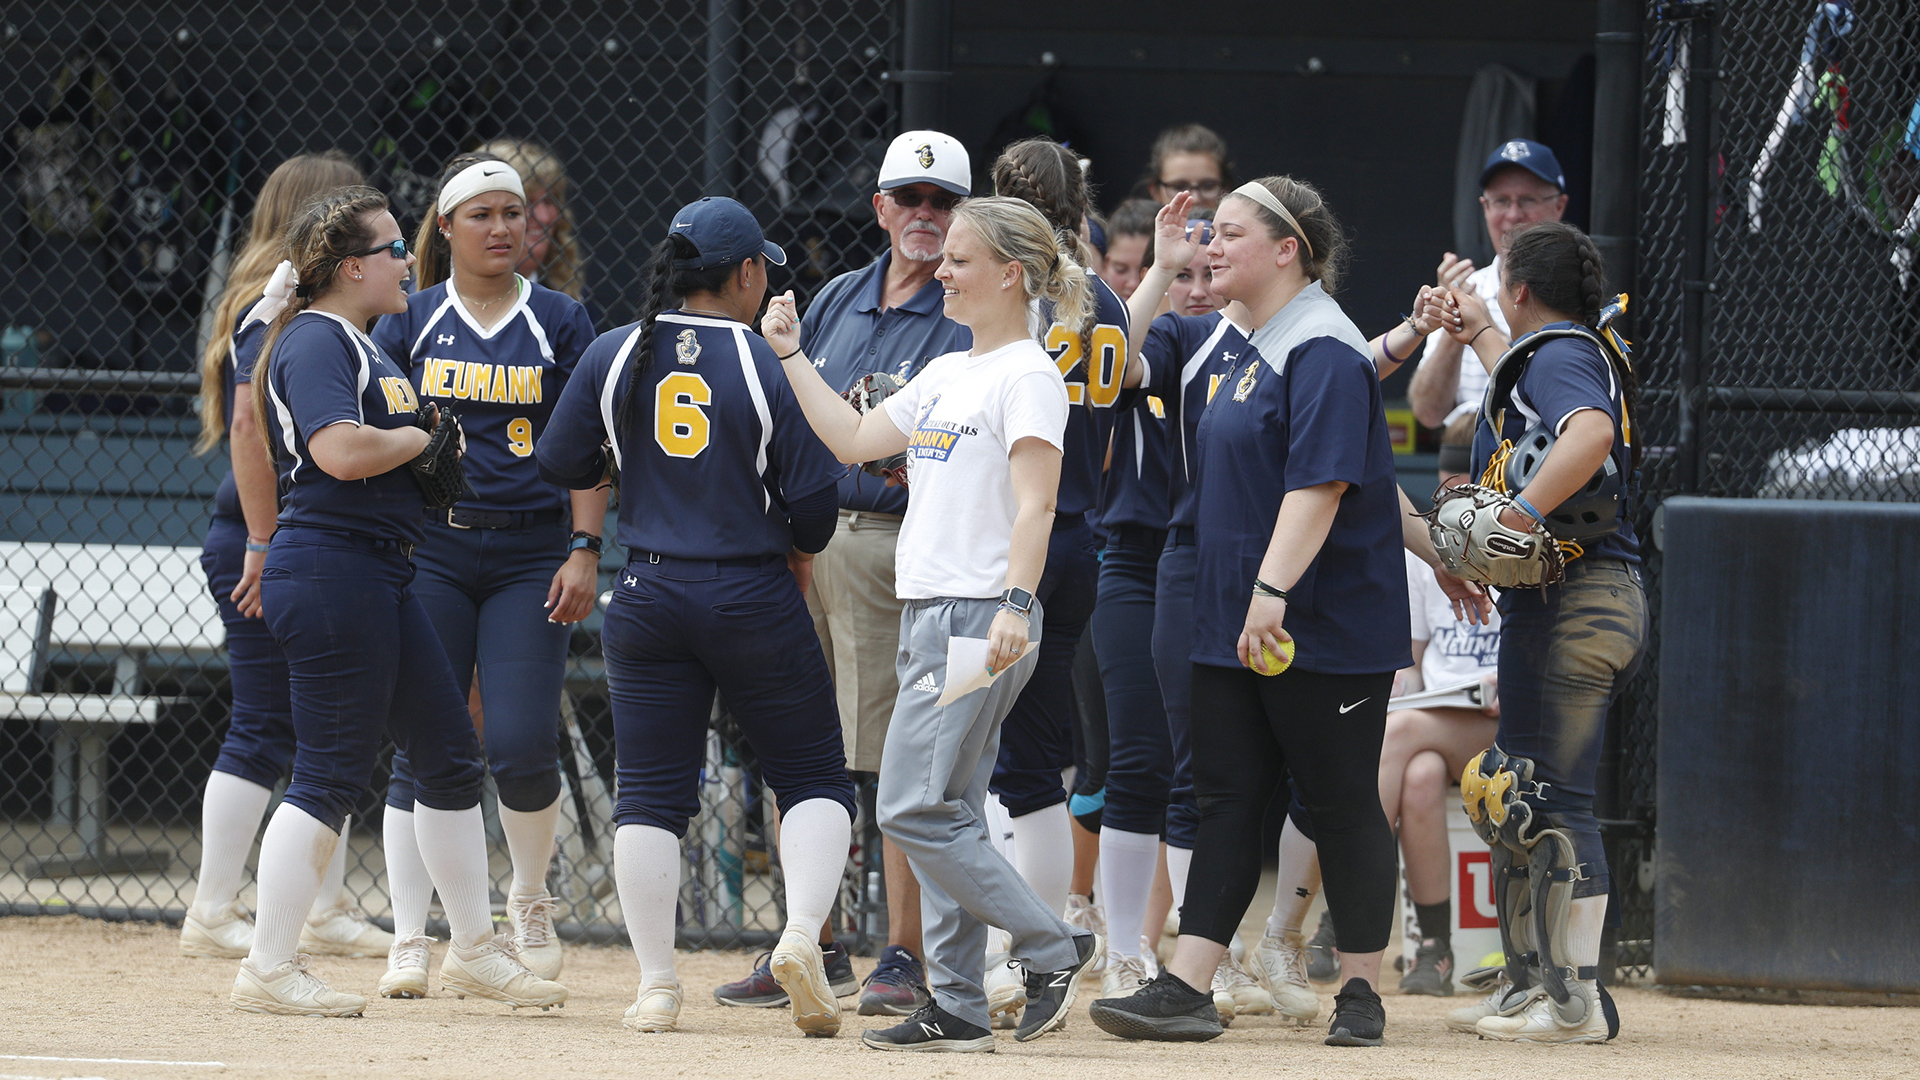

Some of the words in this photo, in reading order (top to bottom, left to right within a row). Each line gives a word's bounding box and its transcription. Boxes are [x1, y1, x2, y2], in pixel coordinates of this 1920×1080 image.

[420, 357, 543, 405] NEUMANN
[1044, 321, 1127, 408] 20
[654, 371, 712, 459] 6
[957, 425, 979, 437] ALS
[506, 417, 534, 458] 9
[909, 430, 957, 450] UMANN
[912, 683, 939, 693] adidas
